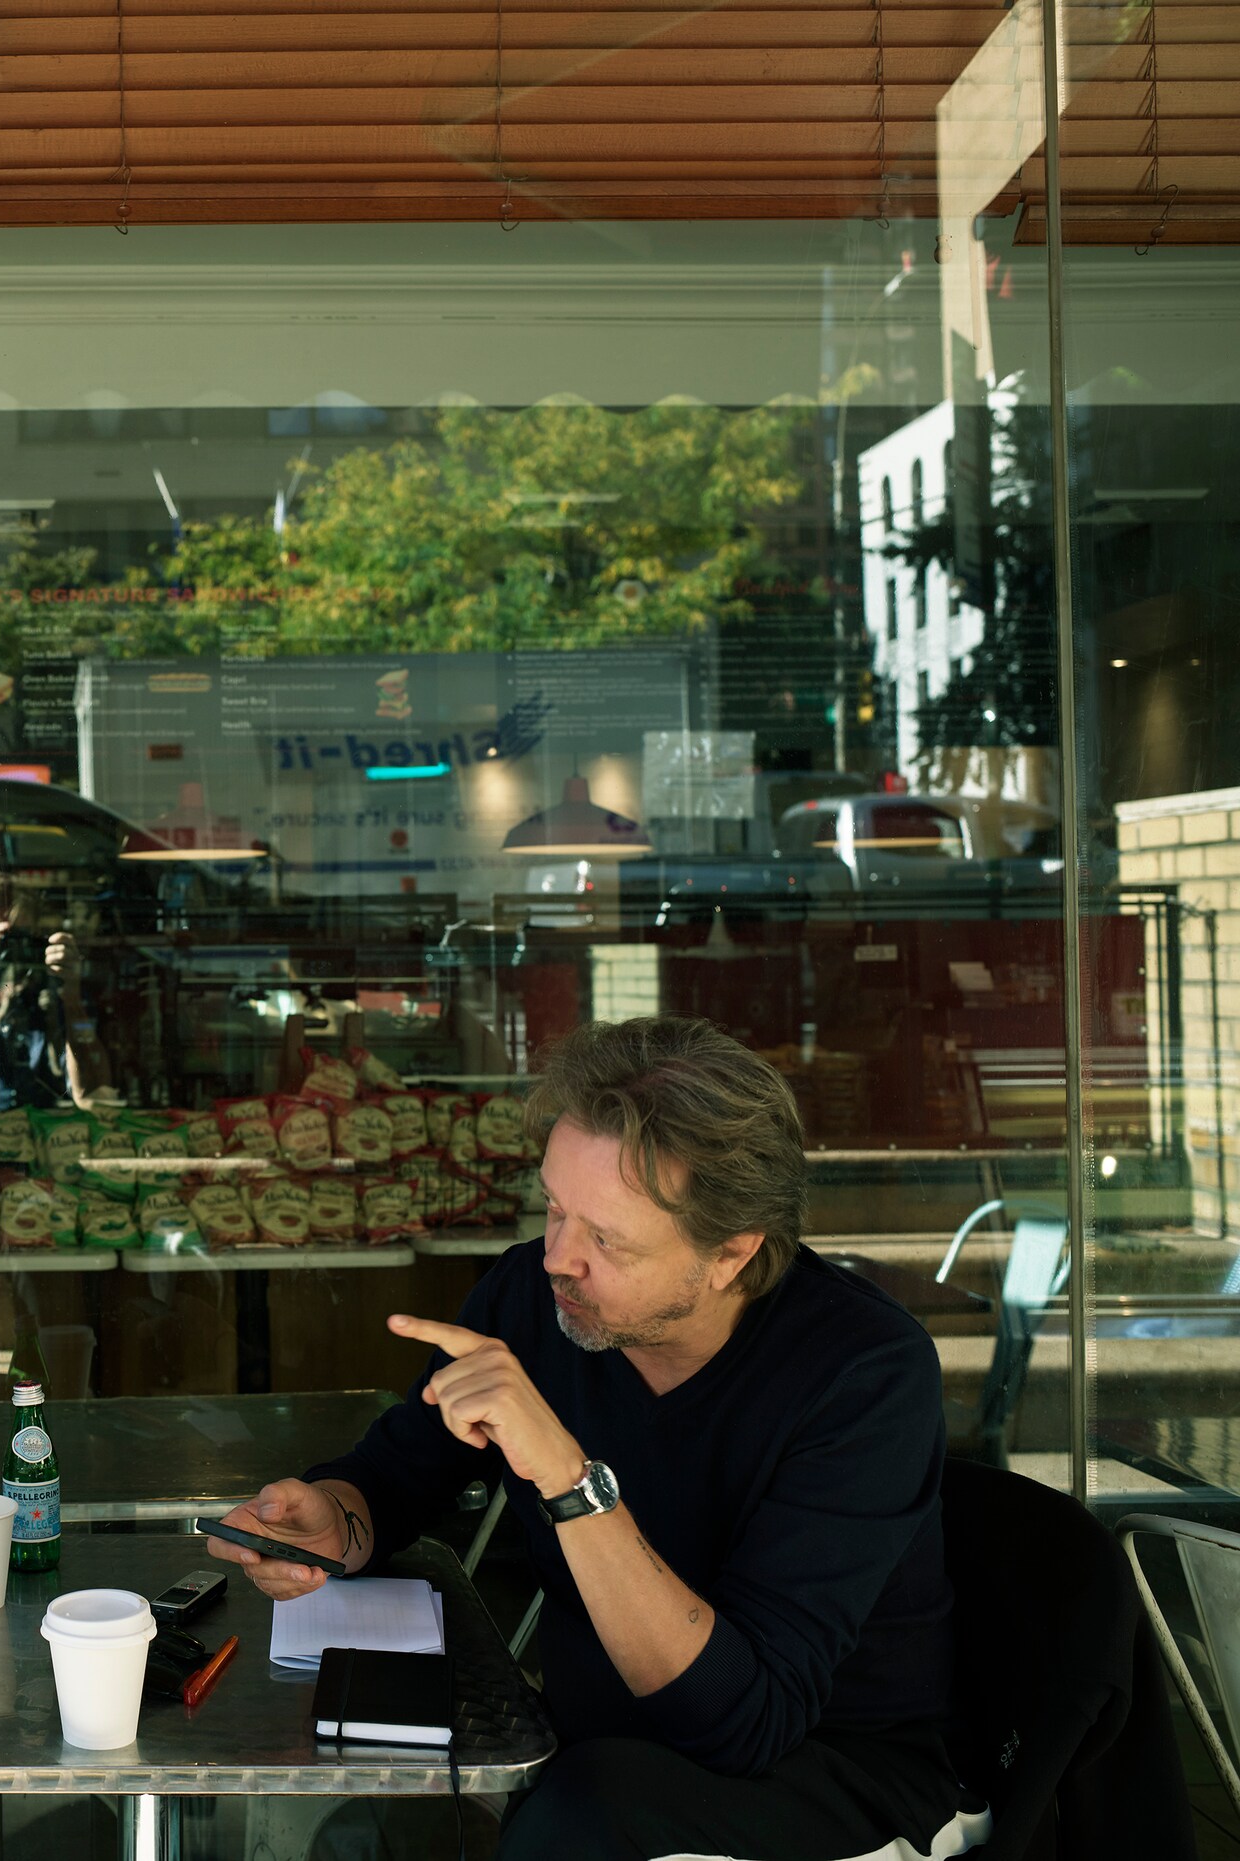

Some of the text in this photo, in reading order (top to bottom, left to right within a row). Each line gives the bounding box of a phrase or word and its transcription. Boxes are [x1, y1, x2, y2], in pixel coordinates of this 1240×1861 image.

[30, 587, 161, 604] SIGNATURE
[221, 675, 247, 684] Capri
[221, 720, 252, 729] Health
